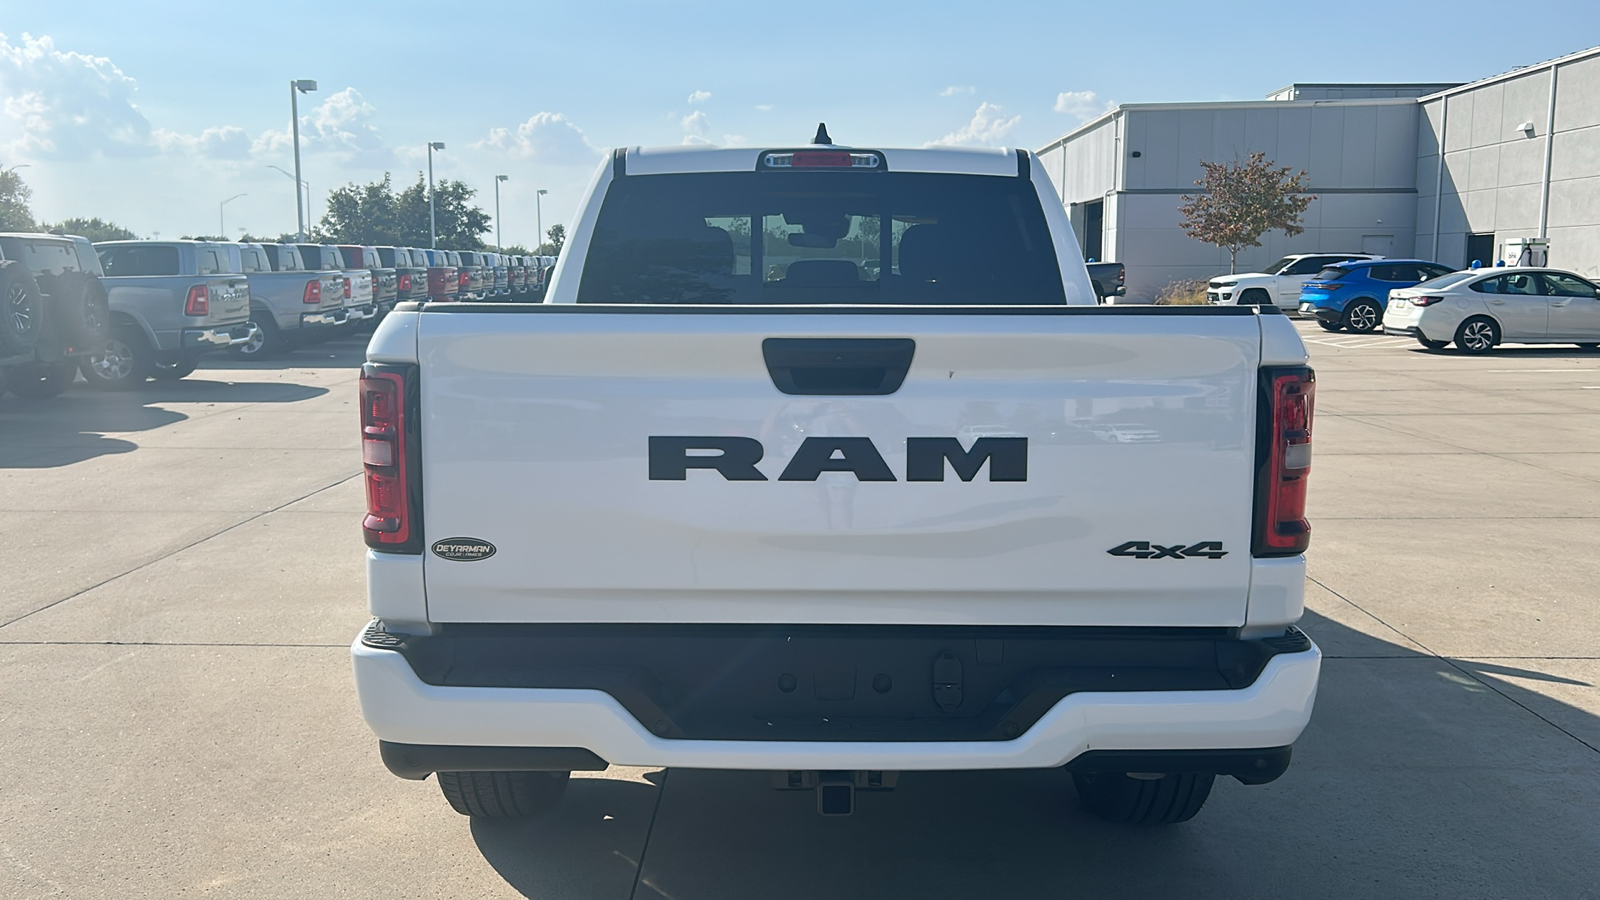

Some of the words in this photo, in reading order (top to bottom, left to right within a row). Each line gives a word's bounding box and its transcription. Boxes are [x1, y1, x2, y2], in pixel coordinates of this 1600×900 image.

[648, 436, 1028, 482] RAM
[436, 544, 491, 553] DEYARMAN
[1106, 541, 1229, 559] 4x4
